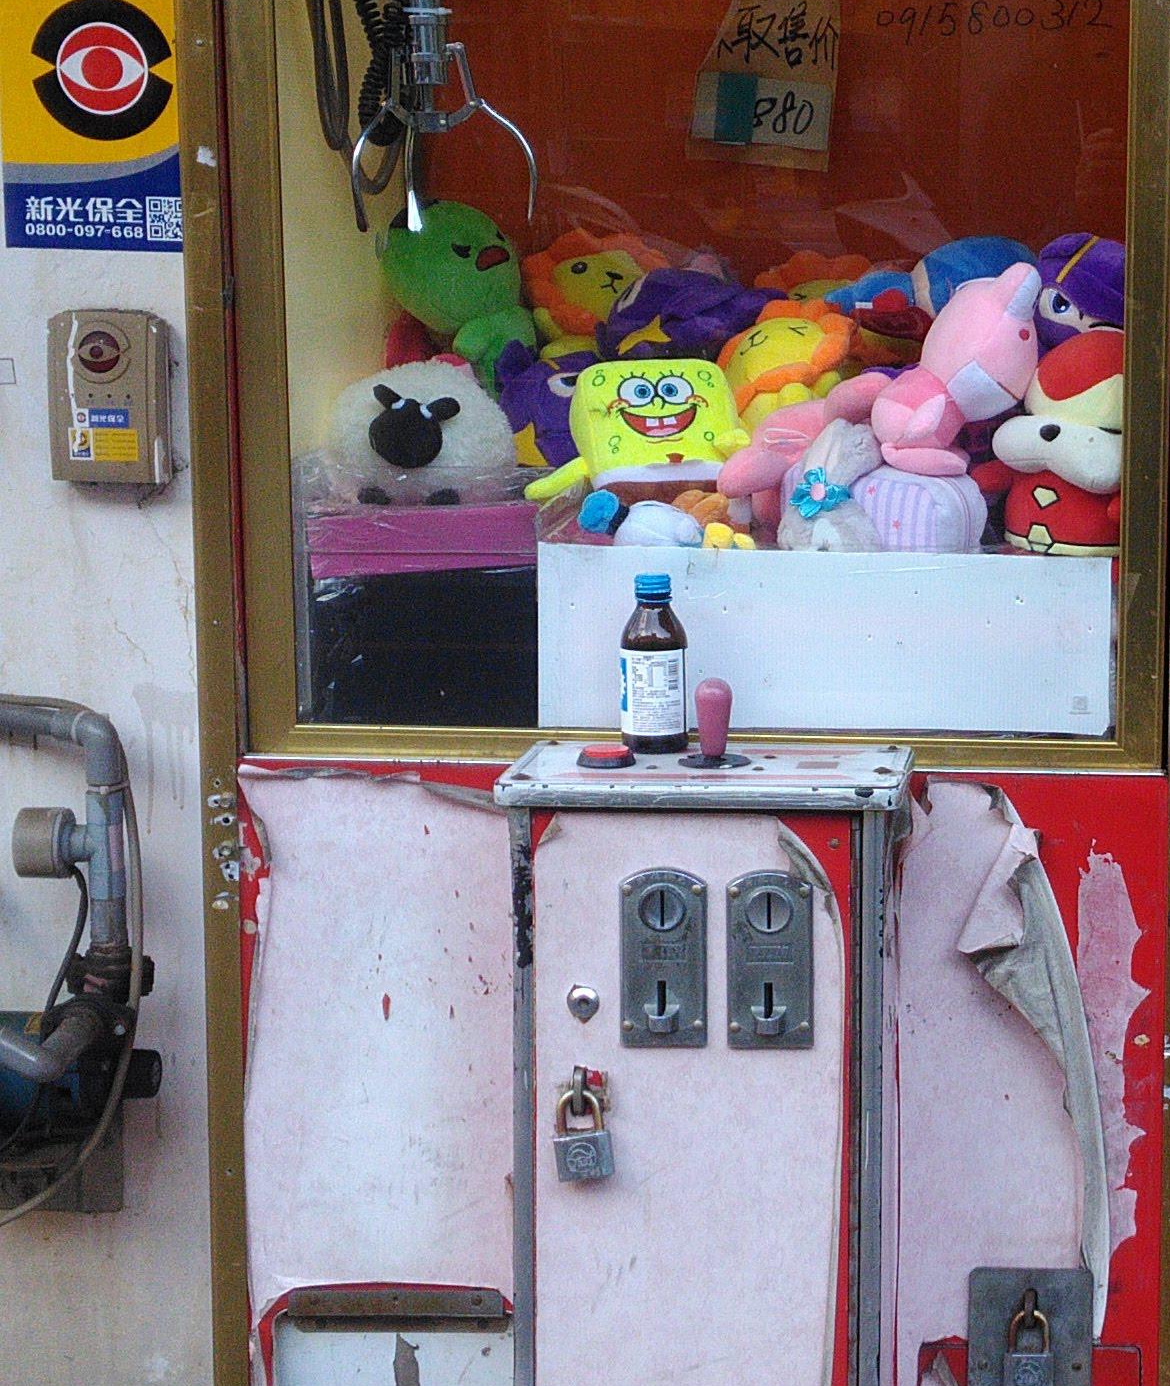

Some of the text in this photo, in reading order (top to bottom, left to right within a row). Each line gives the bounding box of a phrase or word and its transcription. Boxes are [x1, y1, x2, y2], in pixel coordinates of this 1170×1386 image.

[25, 195, 144, 224] 新光保全
[25, 224, 144, 239] 0800-097-668
